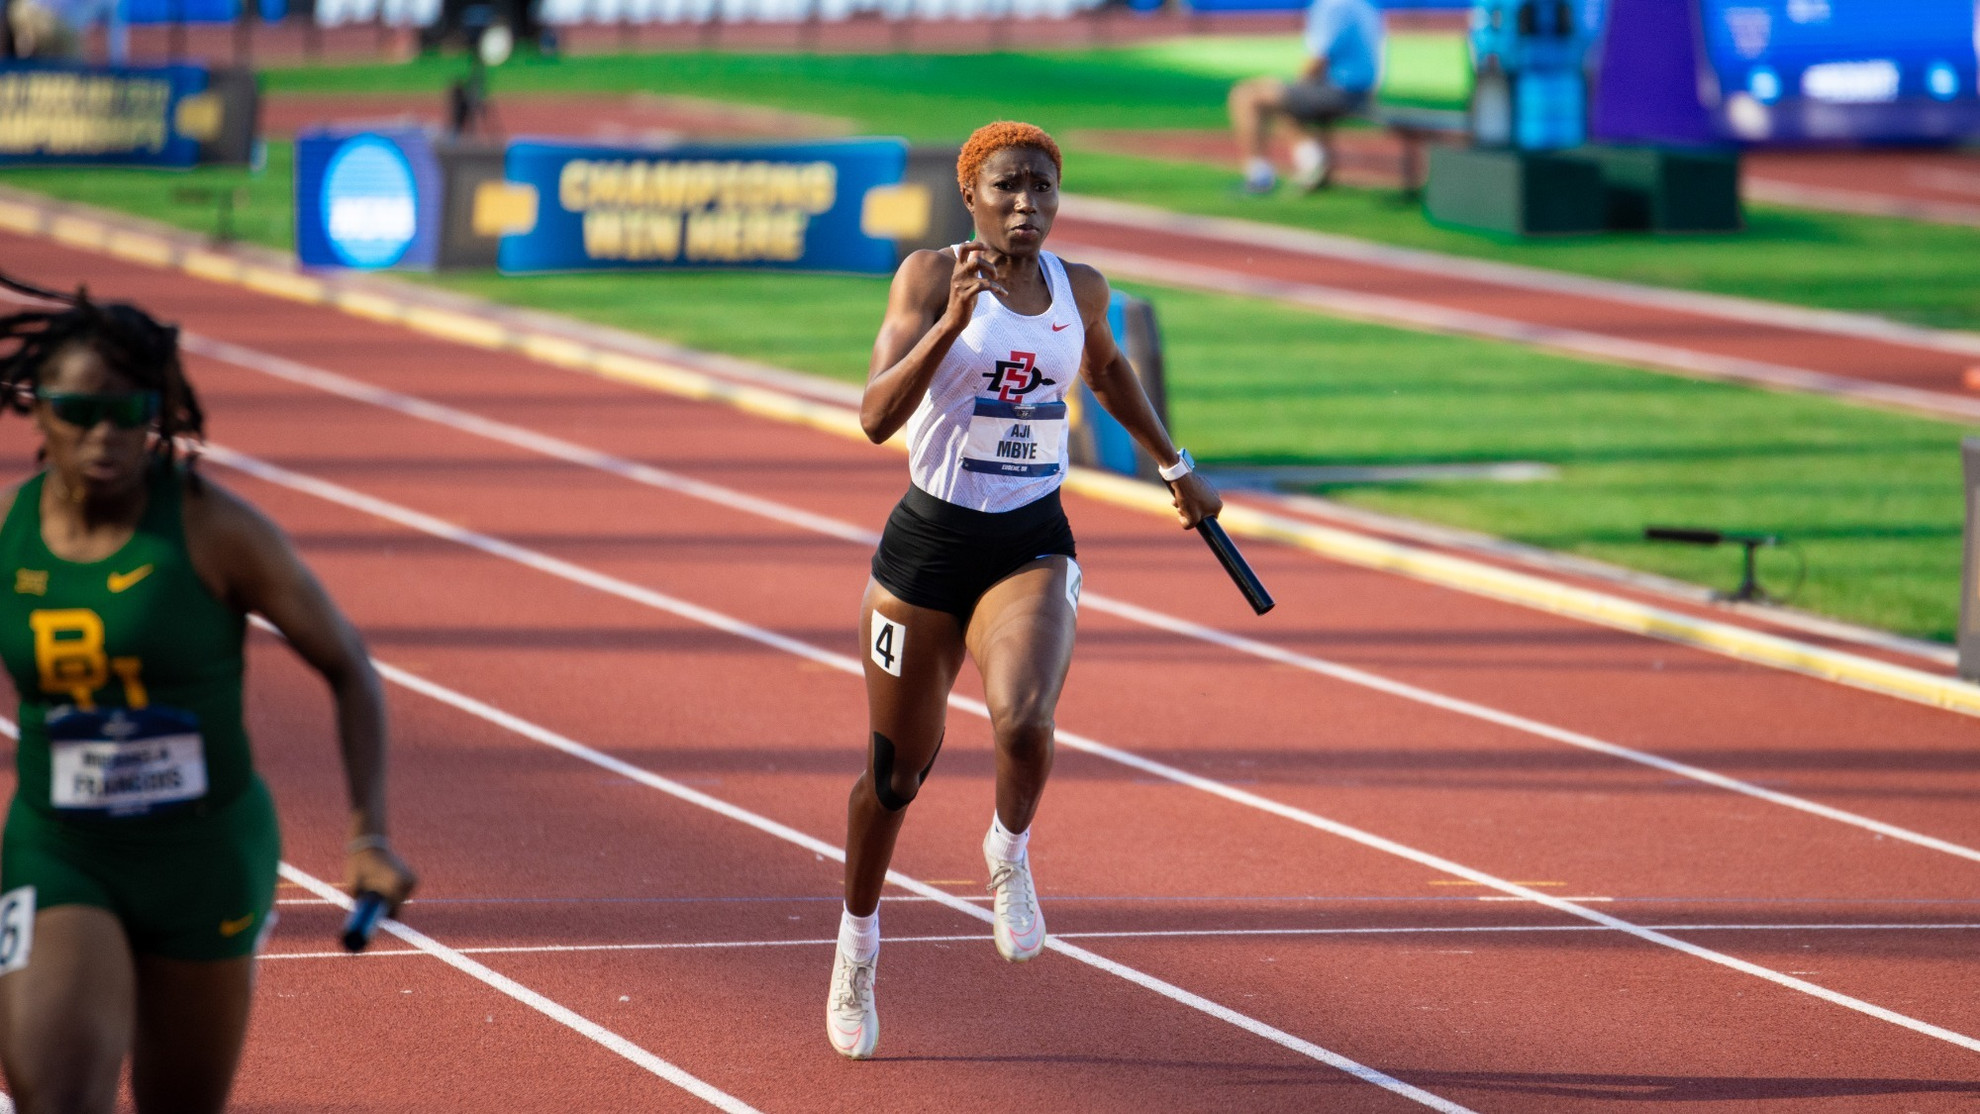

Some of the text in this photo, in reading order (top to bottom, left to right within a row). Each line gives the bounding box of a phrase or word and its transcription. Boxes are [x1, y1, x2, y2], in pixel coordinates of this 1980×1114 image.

[559, 159, 837, 213] CHAMPIONS
[583, 212, 808, 261] WIN HERE
[997, 441, 1037, 459] MBYE
[1011, 424, 1030, 438] AJI
[875, 623, 895, 669] 4
